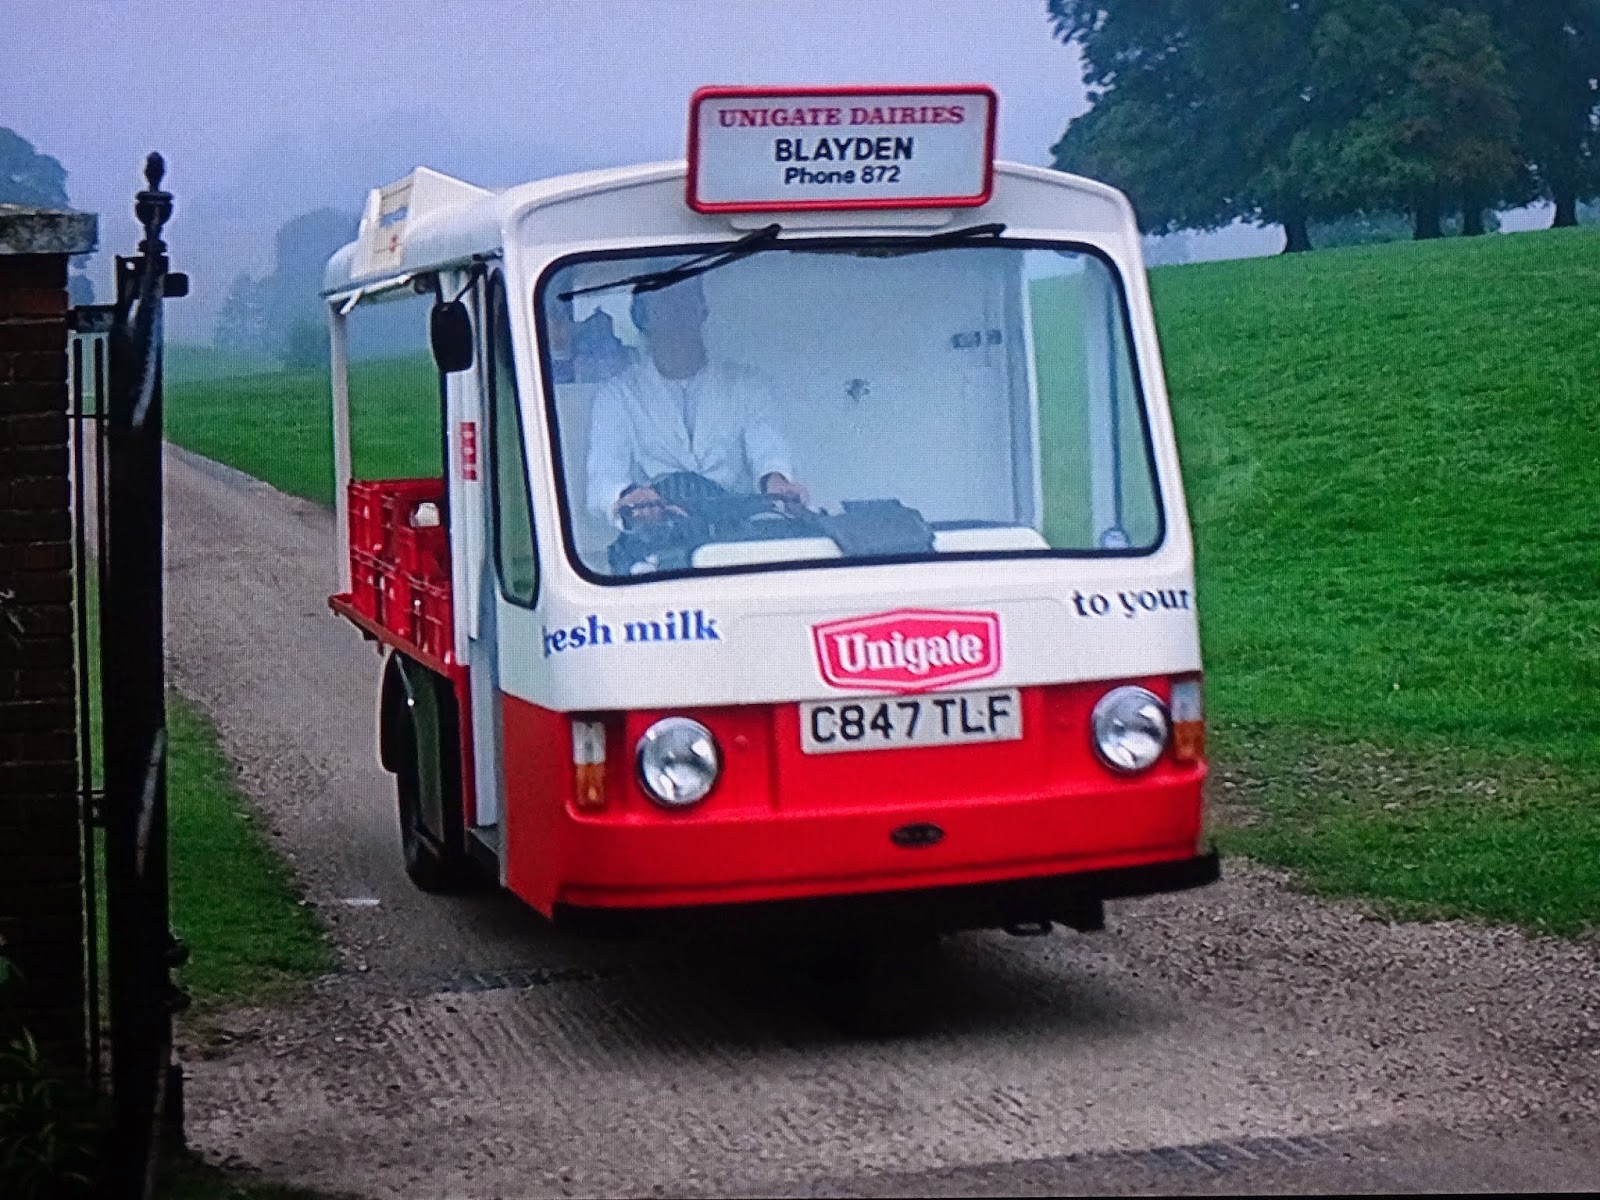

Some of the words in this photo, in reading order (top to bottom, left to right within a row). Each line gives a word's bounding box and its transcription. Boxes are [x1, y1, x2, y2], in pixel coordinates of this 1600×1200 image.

[719, 108, 840, 127] UNIGATE
[850, 106, 965, 125] DAIRIES
[775, 137, 913, 162] BLAYDEN
[784, 168, 855, 185] Phone
[861, 166, 901, 183] 872
[1073, 590, 1110, 616] to
[1118, 589, 1189, 618] your
[624, 610, 720, 642] milk
[834, 629, 984, 675] Unigate
[811, 702, 921, 743] C847
[932, 695, 1012, 736] TLF
